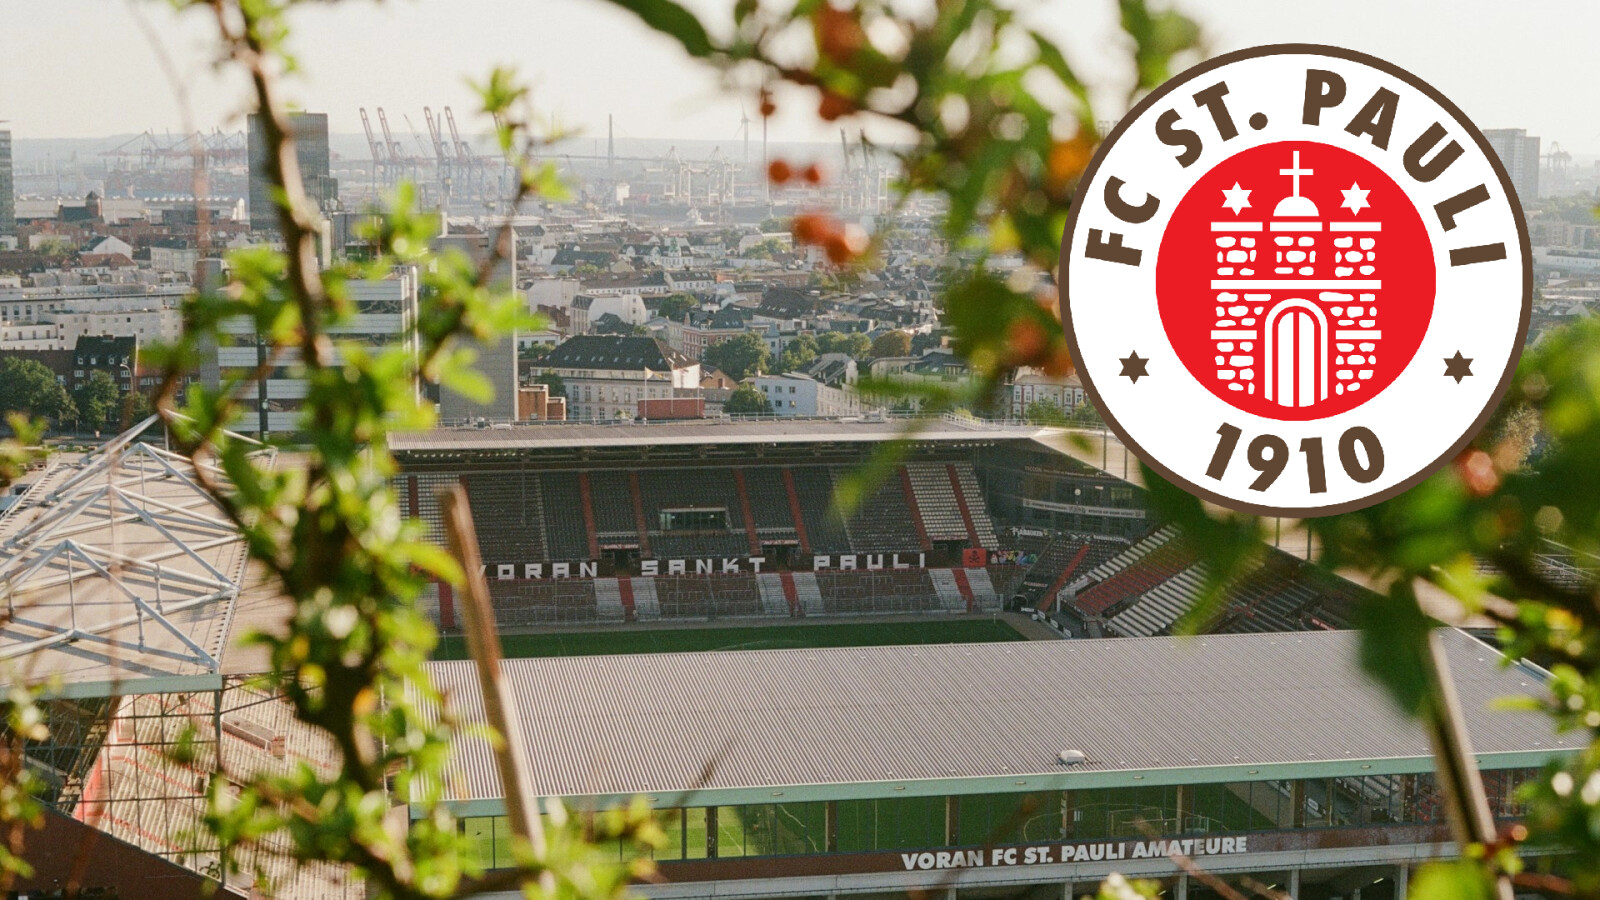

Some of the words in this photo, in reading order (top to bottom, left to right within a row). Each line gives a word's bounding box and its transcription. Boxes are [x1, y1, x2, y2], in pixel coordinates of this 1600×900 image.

[641, 557, 766, 576] SANKT
[813, 552, 926, 571] PAULI
[901, 849, 984, 870] VORAN
[991, 848, 1017, 866] FC
[1023, 846, 1054, 864] ST.
[1061, 842, 1126, 862] PAULI
[1131, 836, 1247, 859] AMATEURE
